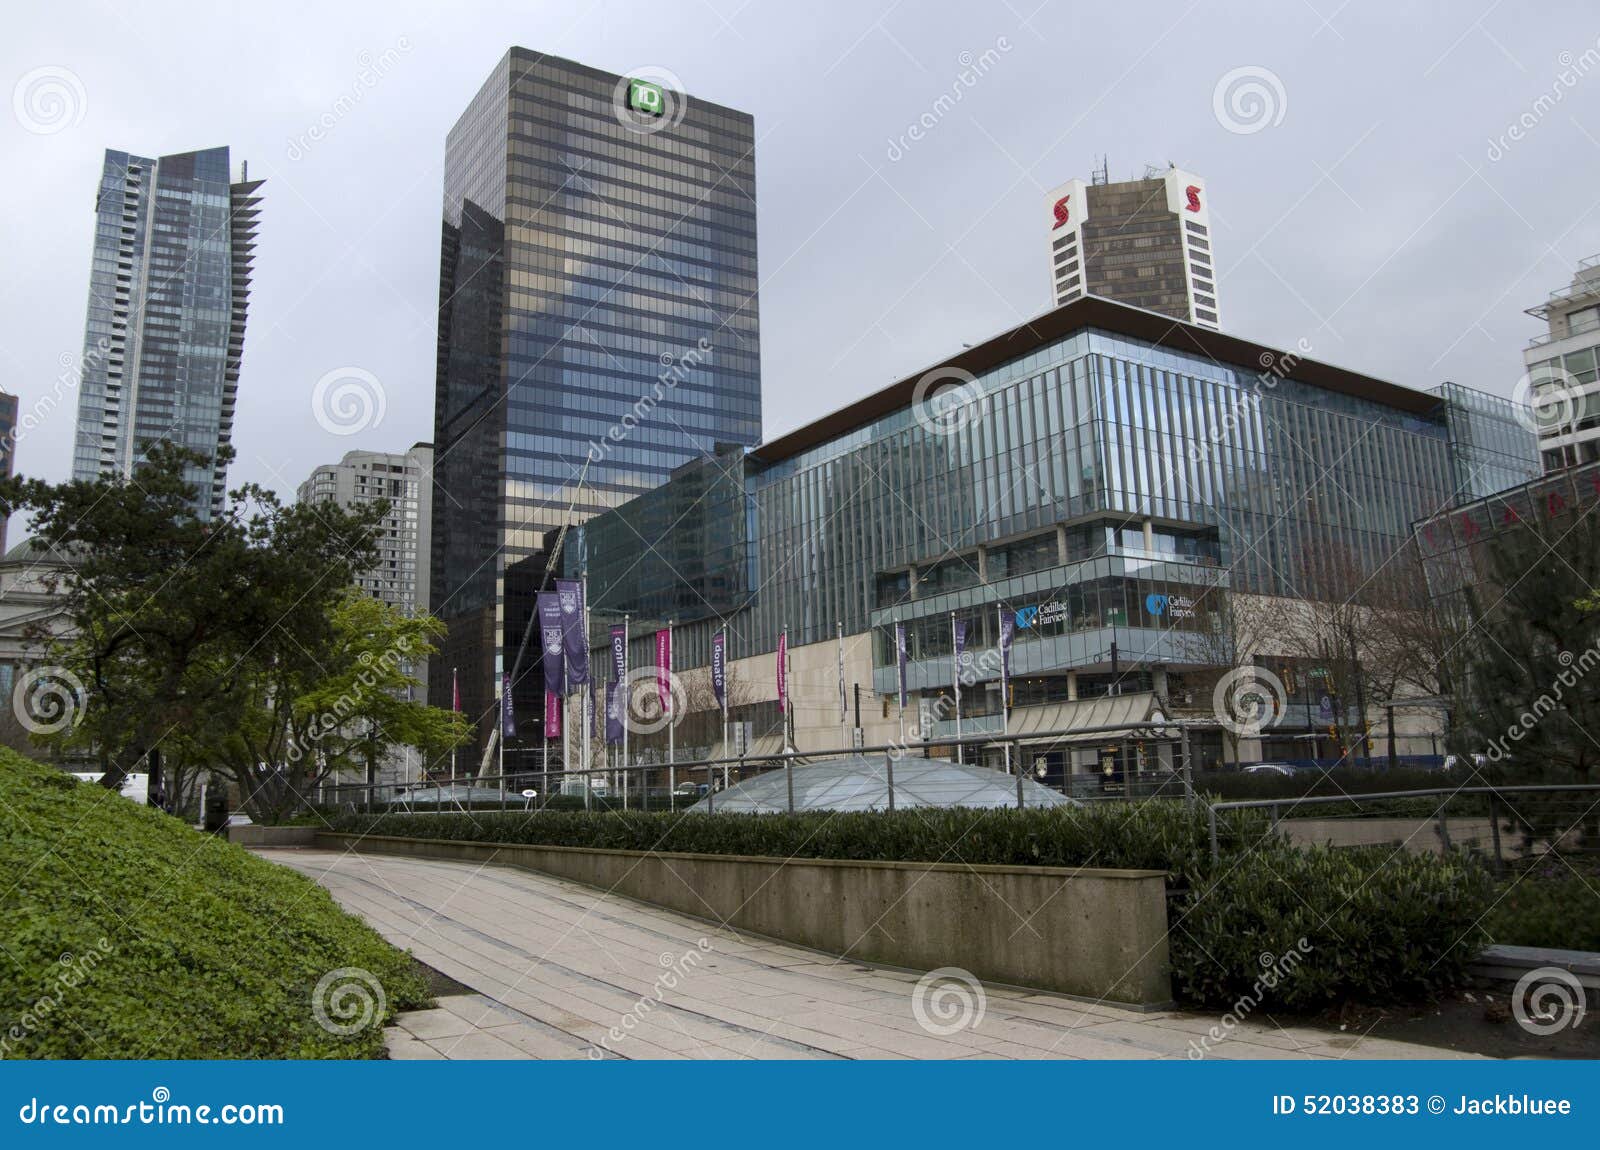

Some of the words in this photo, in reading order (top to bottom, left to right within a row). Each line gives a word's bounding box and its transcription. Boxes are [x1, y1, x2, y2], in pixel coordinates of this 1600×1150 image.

[633, 83, 660, 107] TD
[1038, 600, 1068, 615] Cadillac
[1040, 612, 1068, 625] Fairview
[713, 645, 723, 686] donate
